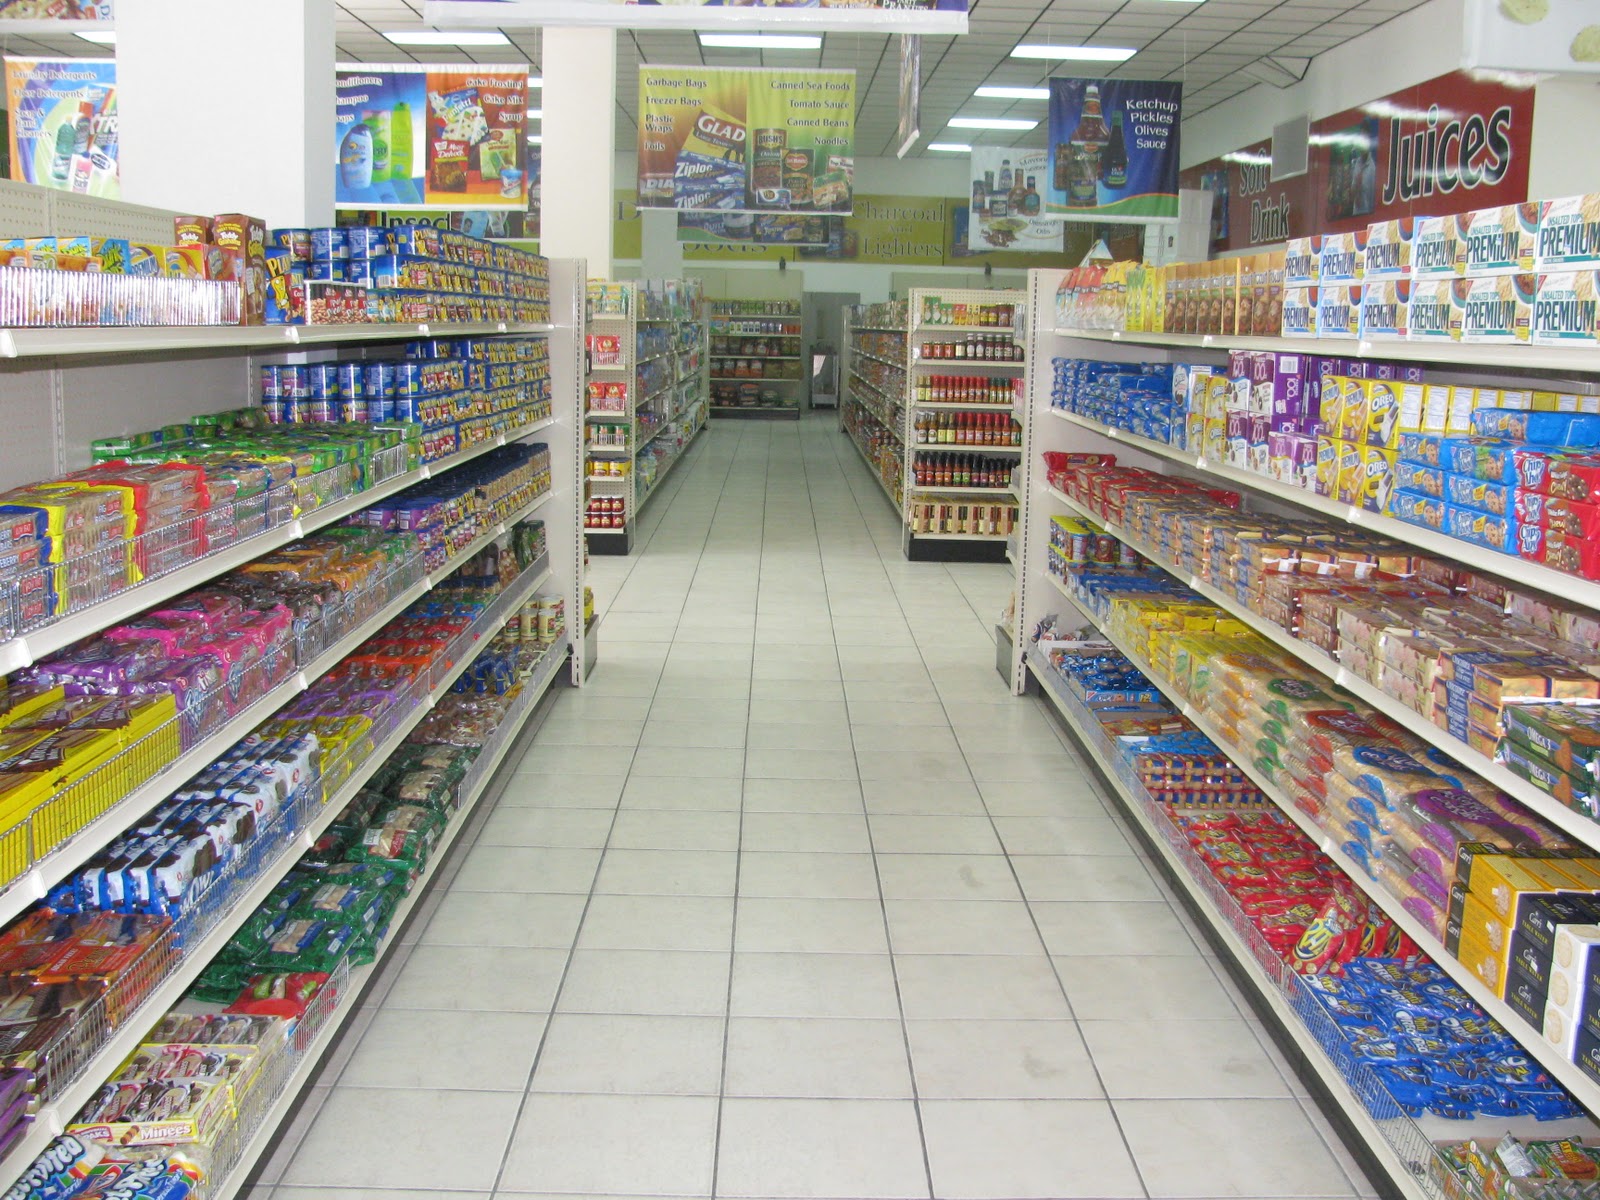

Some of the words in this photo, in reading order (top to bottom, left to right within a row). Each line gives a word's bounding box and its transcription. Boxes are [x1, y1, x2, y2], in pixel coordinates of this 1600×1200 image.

[49, 71, 97, 80] Detergents
[336, 76, 383, 87] onditioners
[466, 77, 488, 87] Cake
[490, 78, 523, 89] Frosting
[646, 78, 682, 88] Garbage
[685, 79, 707, 89] Bags
[37, 89, 84, 99] Detergents
[771, 81, 804, 91] Canned
[807, 82, 822, 91] Sea
[825, 82, 850, 91] Foods
[336, 94, 369, 106] hampoo
[483, 95, 506, 105] Cake
[508, 95, 524, 105] Mix
[646, 96, 677, 105] Freezer
[680, 97, 702, 107] Bags
[789, 100, 821, 108] Tomato
[824, 101, 849, 109] Sauce
[1126, 99, 1178, 113] Ketchup
[336, 113, 355, 124] oaps
[498, 111, 523, 123] Syrup
[645, 114, 674, 123] Plastic
[787, 118, 820, 127] Canned
[823, 118, 849, 127] Beans
[1130, 112, 1174, 124] Pickles
[645, 124, 673, 134] Wraps
[698, 115, 746, 141] GLAD
[1134, 125, 1169, 136] Olives
[643, 142, 666, 151] Foils
[814, 137, 849, 145] Noodles
[1136, 138, 1167, 149] Sauce
[1382, 103, 1511, 205] Juices
[675, 162, 713, 178] Ziploc
[1239, 147, 1270, 197] Soft
[675, 192, 711, 209] Ziploc
[1251, 193, 1290, 244] Drink
[863, 237, 943, 258] Lighters
[1466, 232, 1519, 263] PREMIUM
[1539, 222, 1600, 257] PREMIUM
[1366, 242, 1400, 269] PREMIUM
[1416, 239, 1456, 267] PREMIUM
[1285, 255, 1311, 277] PREMIUM
[1321, 251, 1355, 276] PREMIUM
[1283, 305, 1309, 327] PREMIUM
[1321, 305, 1350, 328] PREMIUM
[1364, 304, 1397, 328] PREMIUM
[1410, 304, 1449, 329] PREMIUM
[1465, 301, 1516, 329] PREMIUM
[1535, 300, 1595, 332] PREMIUM
[1371, 394, 1394, 413] OREO
[1366, 461, 1387, 477] OREO
[1527, 726, 1546, 747] OMEGA
[1528, 760, 1546, 780] OMEGA
[1459, 847, 1472, 865] Carr's
[1451, 886, 1464, 904] Carr's
[1529, 911, 1542, 929] Carr's
[1447, 921, 1460, 939] Carr's
[1521, 920, 1534, 935] TABLE
[1534, 929, 1548, 945] WATER
[1515, 955, 1528, 971] TABLE
[1518, 984, 1532, 1003] Carr's
[1511, 992, 1524, 1007] TABLE
[1523, 1002, 1538, 1019] WATER
[141, 1124, 192, 1140] Minees
